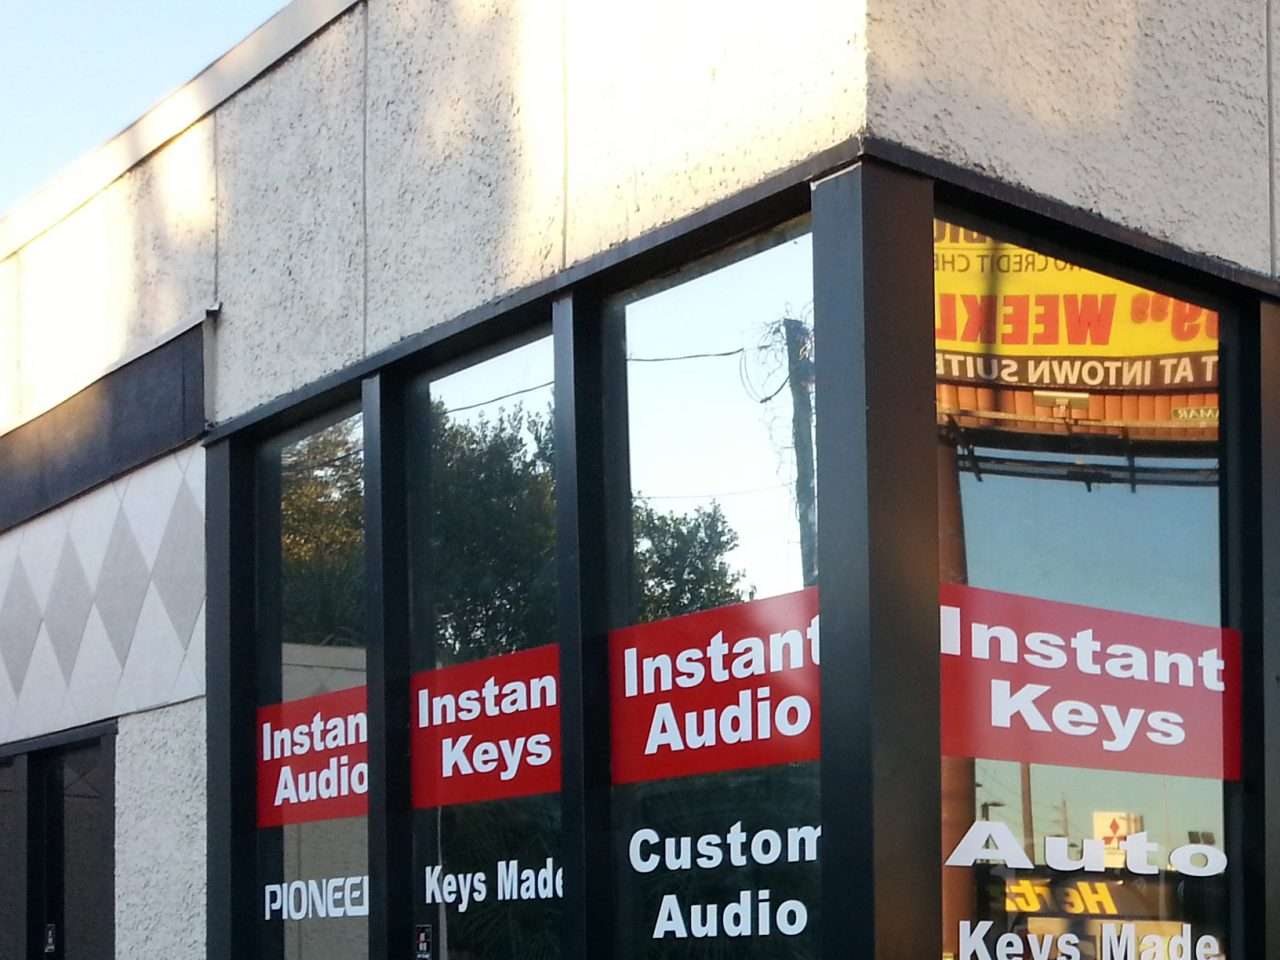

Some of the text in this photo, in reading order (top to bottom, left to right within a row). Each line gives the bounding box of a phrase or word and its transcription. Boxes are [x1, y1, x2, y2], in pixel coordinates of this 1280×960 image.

[939, 605, 1226, 692] Instant
[417, 673, 558, 730] Instan
[644, 687, 812, 756] Audio
[990, 679, 1186, 752] Keys
[262, 710, 369, 762] Instan
[441, 733, 553, 781] Keys
[273, 756, 369, 807] Audio
[629, 820, 823, 875] Custom
[944, 819, 1229, 878] Auto
[425, 865, 487, 913] Keys
[653, 889, 809, 941] Audio
